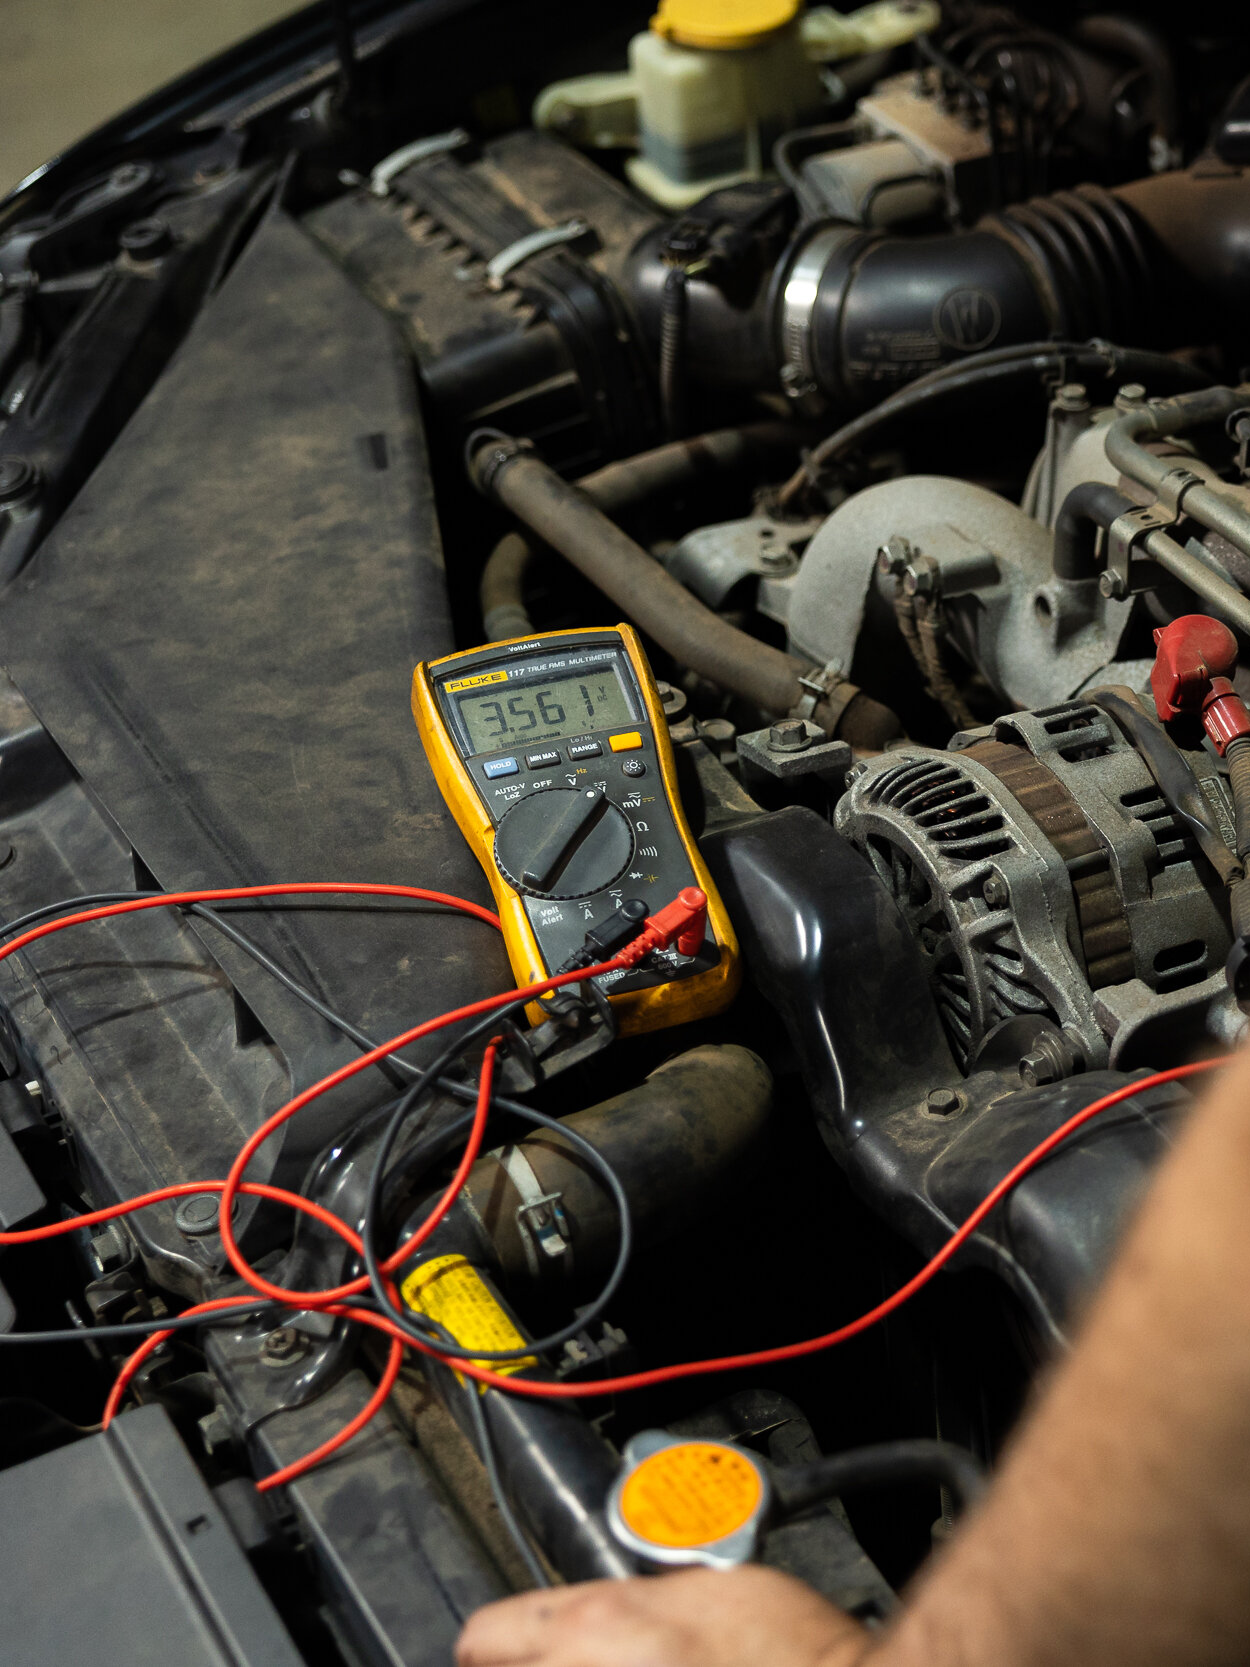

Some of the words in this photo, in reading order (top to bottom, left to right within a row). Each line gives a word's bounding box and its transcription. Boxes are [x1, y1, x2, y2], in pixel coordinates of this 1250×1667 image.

[508, 641, 541, 652] VoltAlert
[450, 673, 502, 690] FLUKE
[508, 668, 525, 678] 117
[527, 664, 547, 673] TRUE
[548, 660, 566, 669] RMS
[568, 651, 617, 665] MULTIMETER
[479, 684, 594, 737] 3.561
[572, 743, 598, 754] RANGE
[530, 754, 542, 763] MIN
[542, 752, 557, 760] MAX
[490, 761, 511, 770] HOLD
[533, 780, 553, 789] OFF
[567, 778, 577, 786] V
[494, 783, 526, 796] AUTO-V
[622, 798, 641, 808] mV
[540, 906, 560, 917] Volt
[584, 908, 594, 920] A
[542, 913, 564, 926] Alert
[598, 971, 626, 984] FUSED
